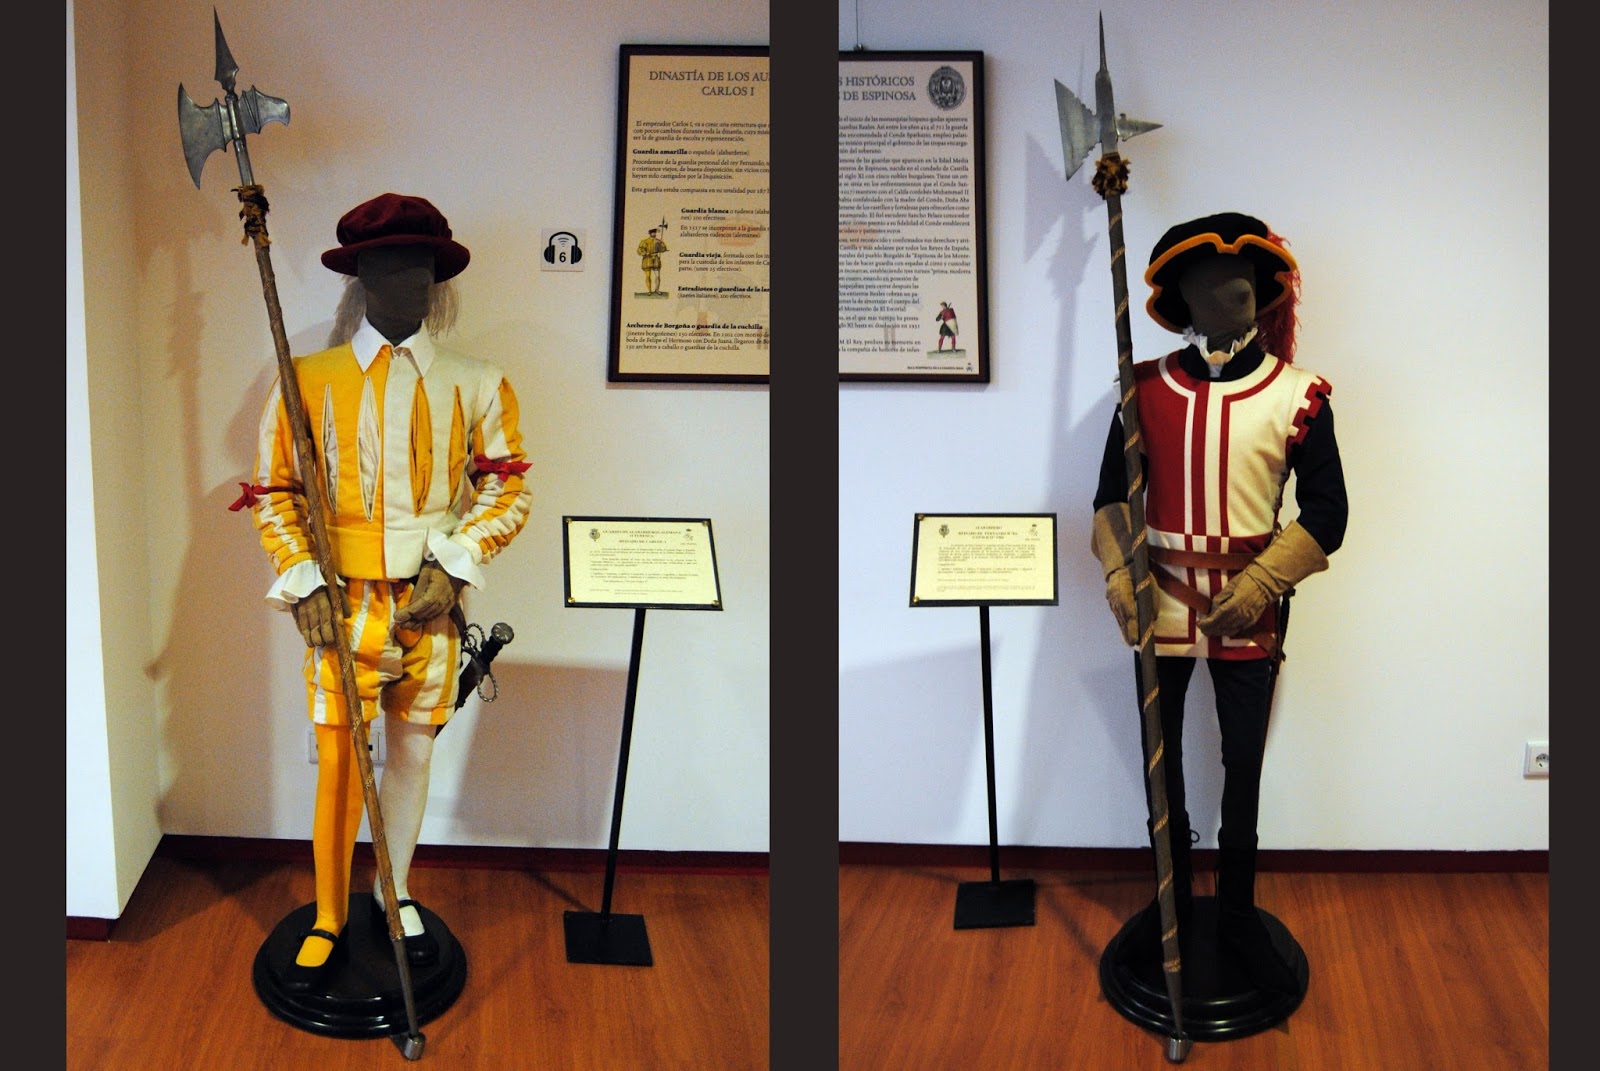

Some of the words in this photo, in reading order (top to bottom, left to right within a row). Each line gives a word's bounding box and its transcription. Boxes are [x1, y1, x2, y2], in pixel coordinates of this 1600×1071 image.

[649, 70, 704, 80] DINASTÍA
[708, 72, 724, 81] DE
[728, 72, 750, 81] LOS
[846, 76, 914, 86] HISTÓRICOS
[702, 86, 748, 96] CARLOS
[750, 86, 754, 96] I
[843, 92, 858, 100] DE
[862, 92, 916, 100] ESPINOSA
[643, 120, 671, 129] emperador
[655, 134, 674, 142] guardia
[693, 149, 715, 157] española
[716, 149, 750, 157] (alabarderos)
[678, 159, 697, 167] guardia
[698, 159, 720, 167] personal
[643, 186, 662, 194] guardia
[747, 225, 766, 233] guardia
[559, 252, 566, 262] 6
[718, 286, 745, 294] guardias
[664, 322, 690, 330] Borgoña
[696, 323, 721, 331] guardia
[646, 336, 662, 345] Felipe
[685, 344, 705, 352] guardias
